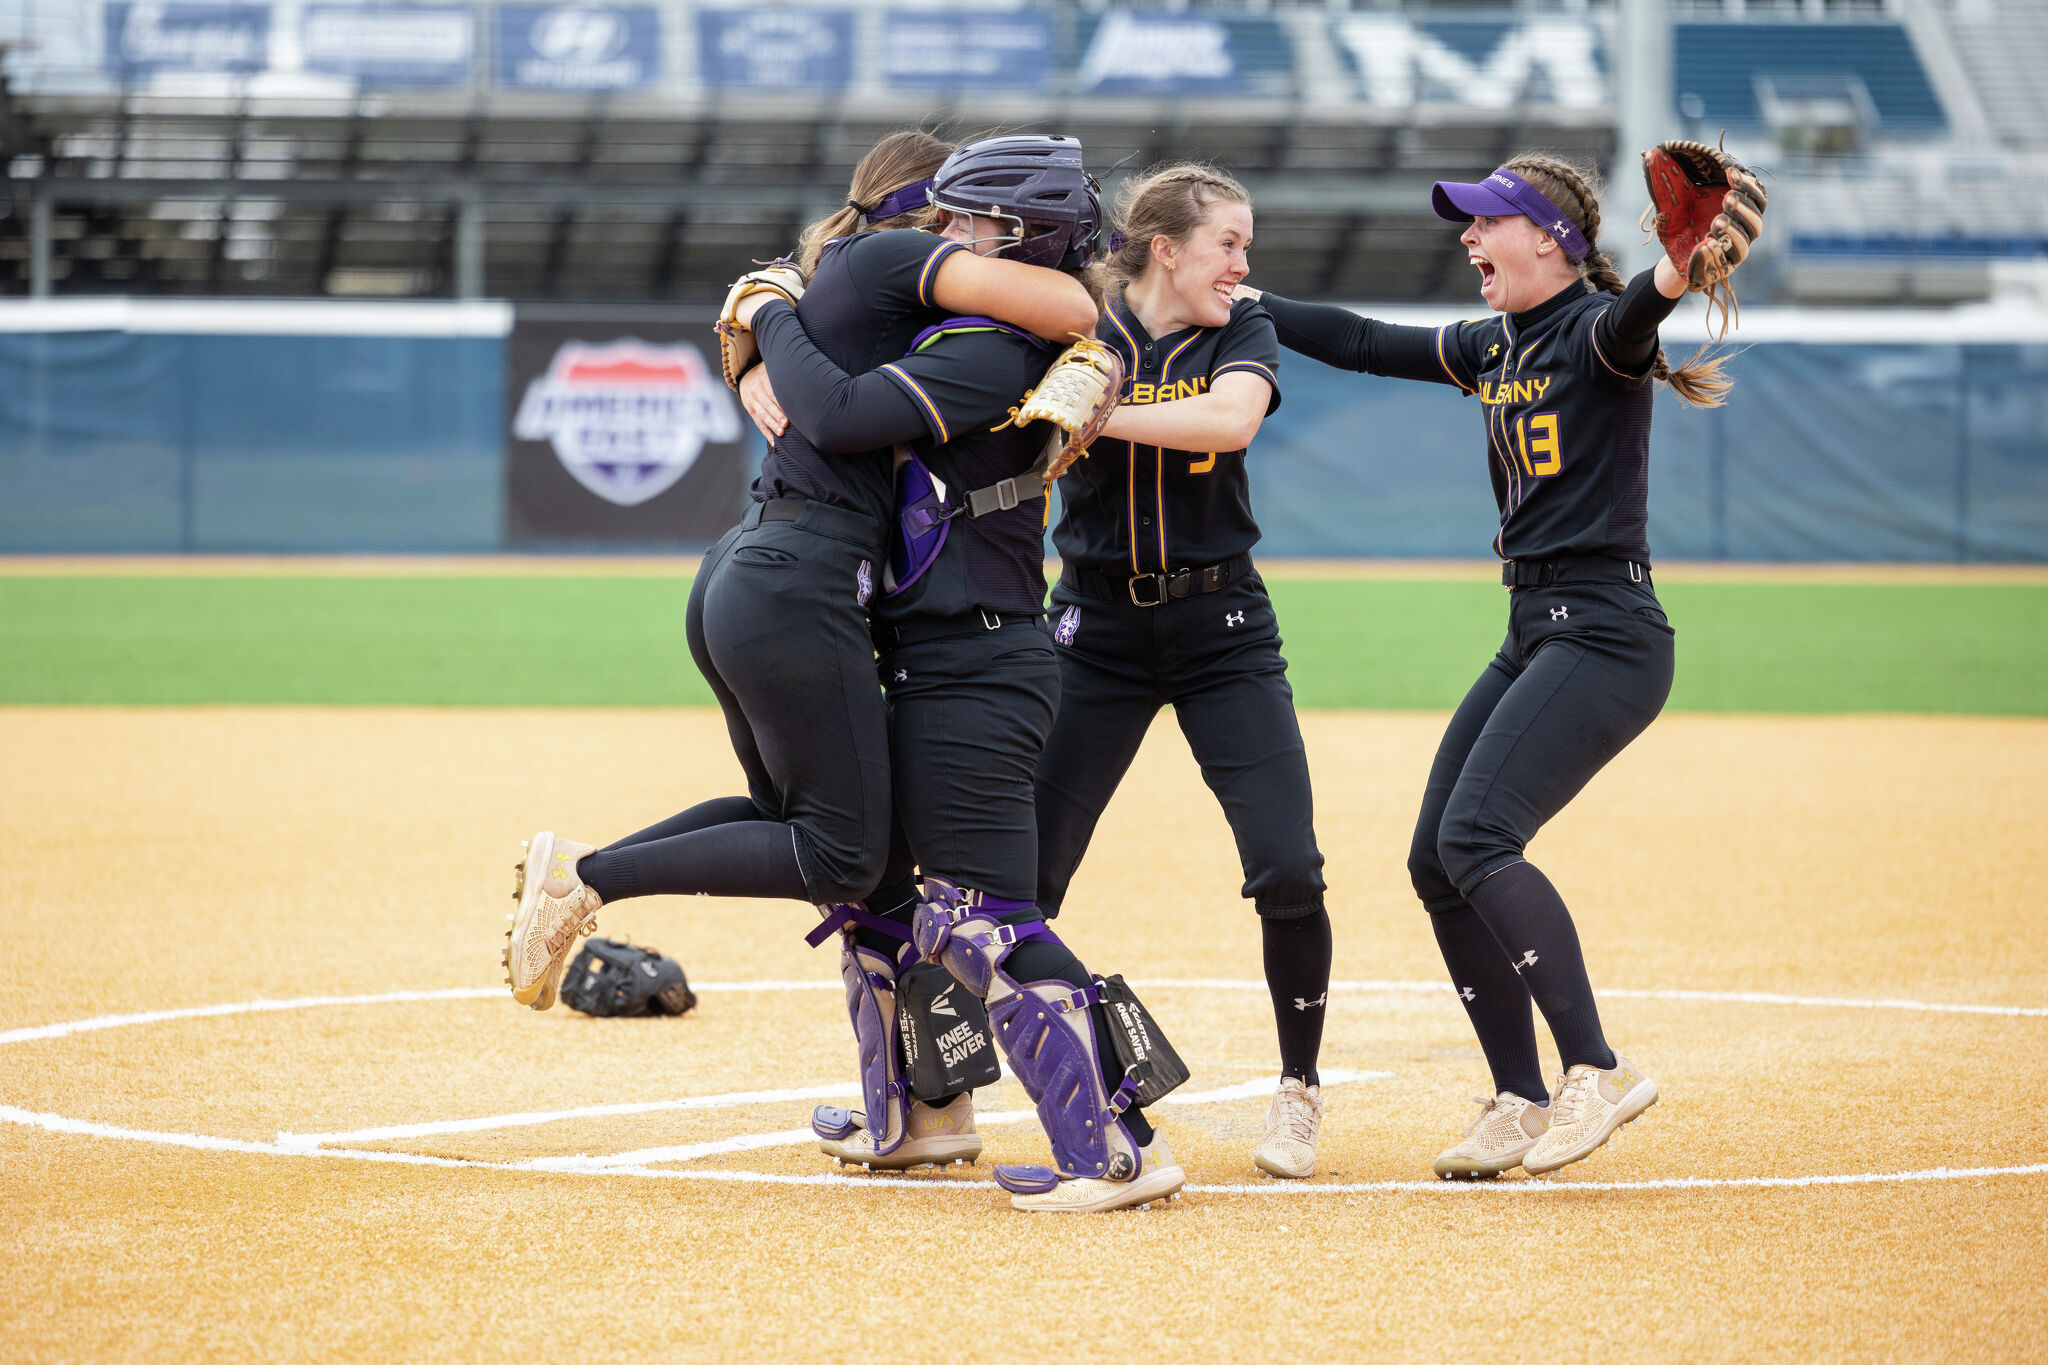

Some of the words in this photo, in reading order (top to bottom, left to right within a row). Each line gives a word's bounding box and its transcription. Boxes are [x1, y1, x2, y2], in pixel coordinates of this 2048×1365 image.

[1336, 21, 1604, 108] M
[1515, 411, 1564, 478] 13
[903, 1032, 913, 1065] SAVER
[935, 1020, 973, 1053] KNEE
[942, 1032, 987, 1068] SAVER
[1115, 1002, 1133, 1029] KNEE
[1128, 1027, 1146, 1061] SAVER
[1132, 1011, 1152, 1051] EASTON
[924, 1113, 957, 1130] UA
